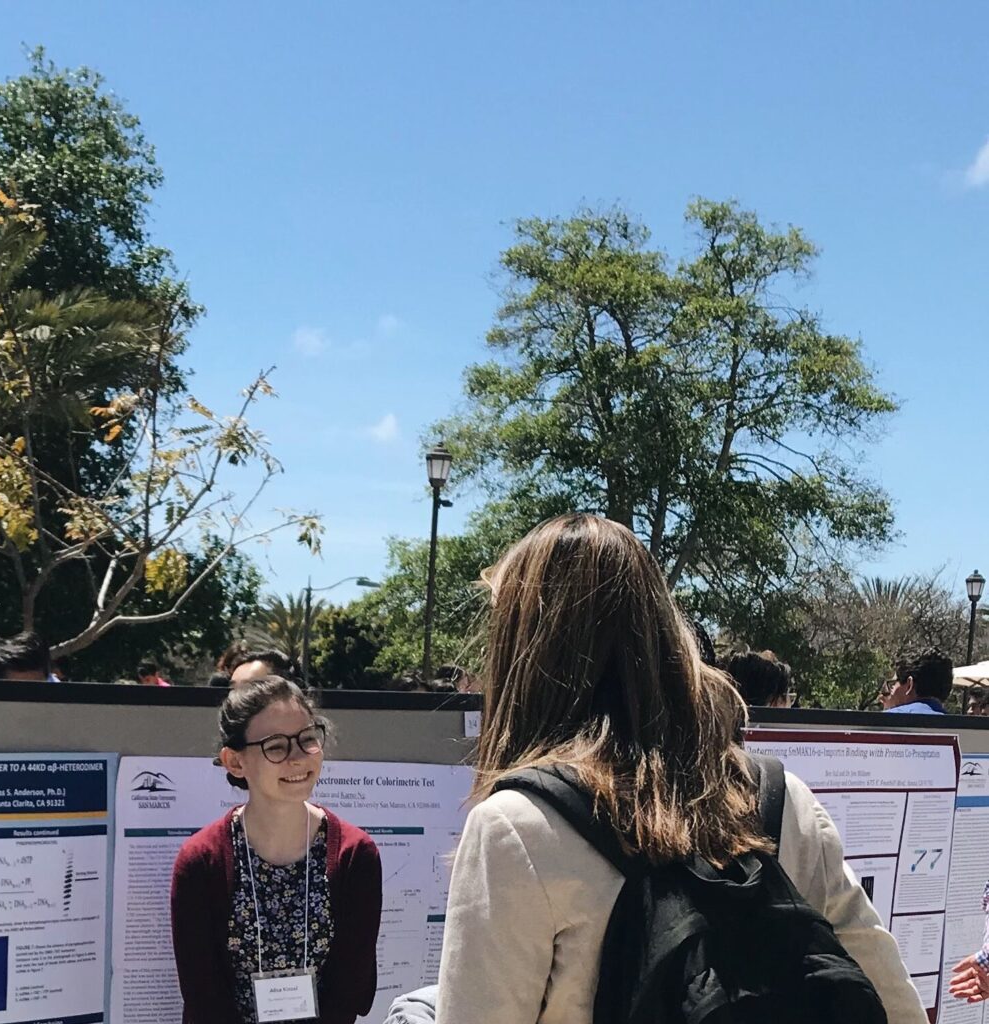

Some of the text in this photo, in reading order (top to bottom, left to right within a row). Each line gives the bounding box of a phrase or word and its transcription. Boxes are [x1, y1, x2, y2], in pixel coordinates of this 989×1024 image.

[869, 748, 884, 758] with
[10, 763, 19, 772] TO
[20, 763, 26, 772] A
[316, 776, 435, 787] pectrometer for Colorimetric Test
[14, 788, 46, 798] Anderson,
[12, 800, 35, 808] Clarita,
[36, 800, 45, 808] CA
[46, 799, 65, 807] 91321
